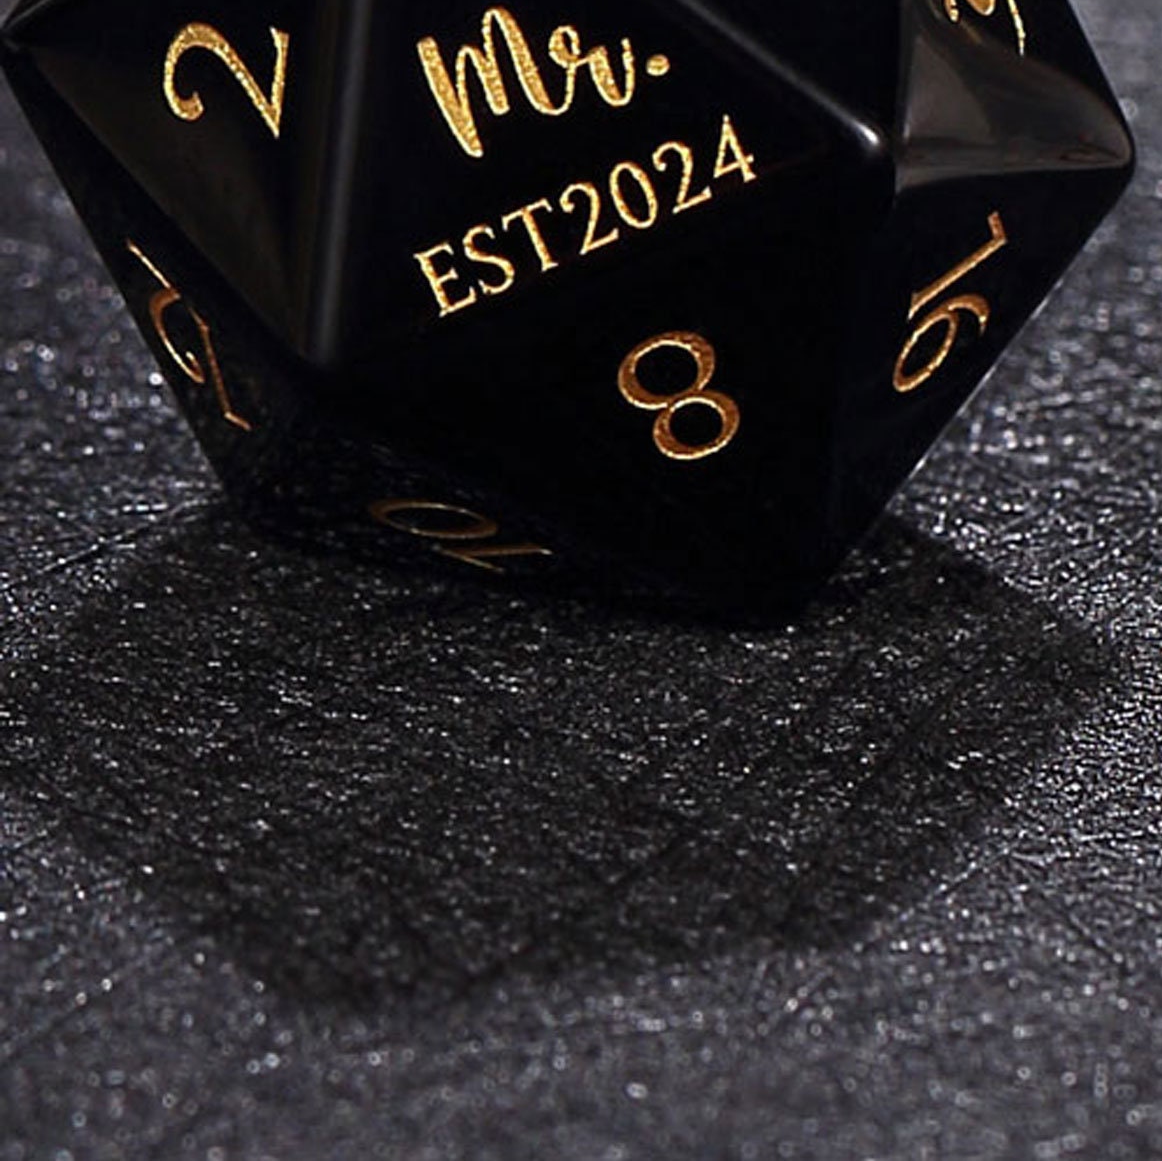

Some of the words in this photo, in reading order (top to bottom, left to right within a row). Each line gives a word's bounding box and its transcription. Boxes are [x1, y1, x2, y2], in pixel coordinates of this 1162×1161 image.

[163, 21, 290, 139] 2
[416, 5, 671, 159] Mr.
[412, 114, 757, 319] EST2024
[892, 210, 1007, 393] 16
[617, 331, 741, 461] 8
